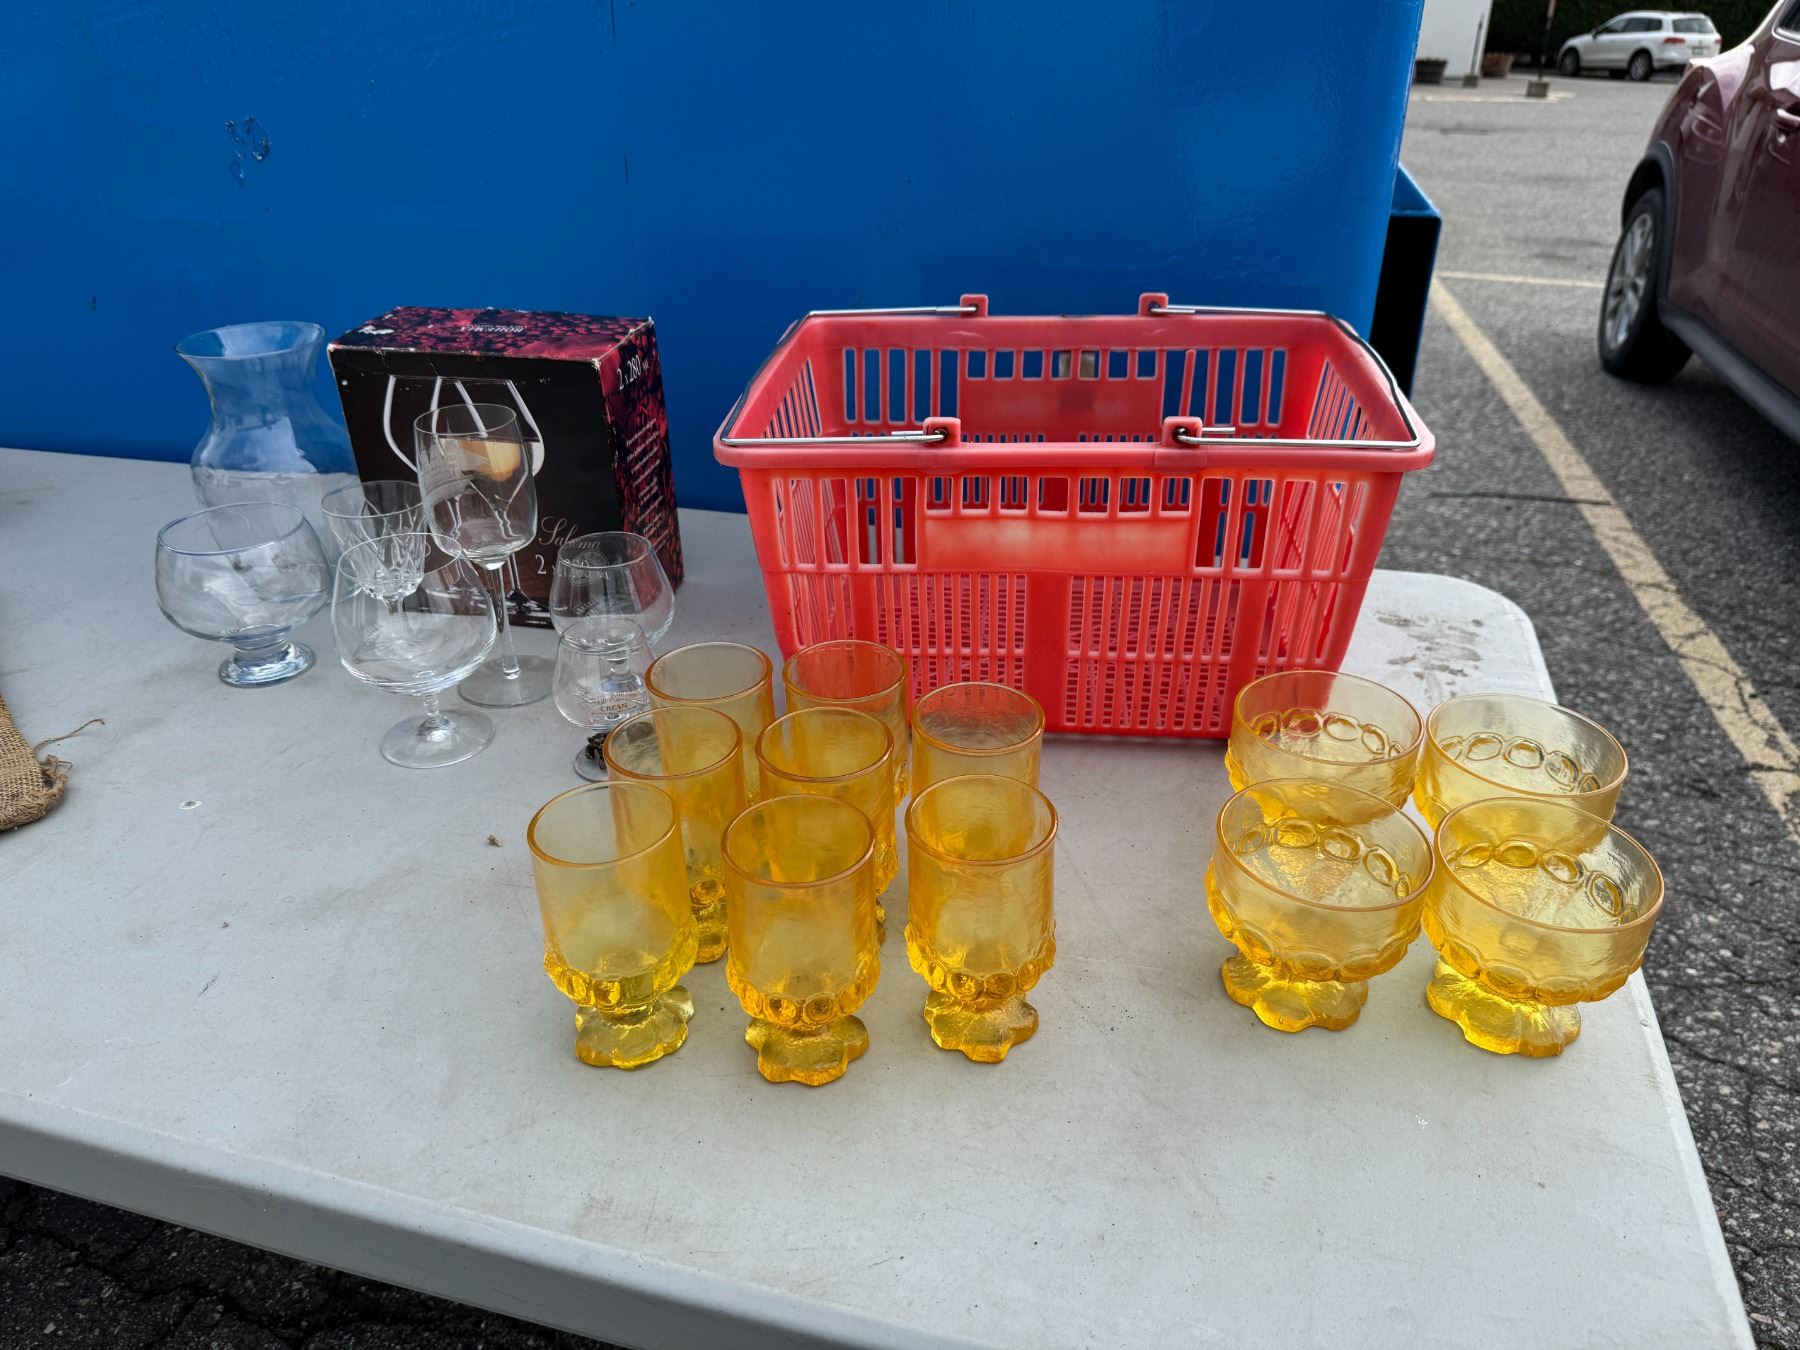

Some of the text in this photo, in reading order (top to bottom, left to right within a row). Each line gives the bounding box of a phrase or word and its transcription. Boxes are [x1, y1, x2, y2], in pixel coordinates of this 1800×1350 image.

[616, 367, 625, 391] 2
[626, 354, 642, 383] 280
[538, 516, 601, 550] Salma
[535, 554, 547, 575] 2
